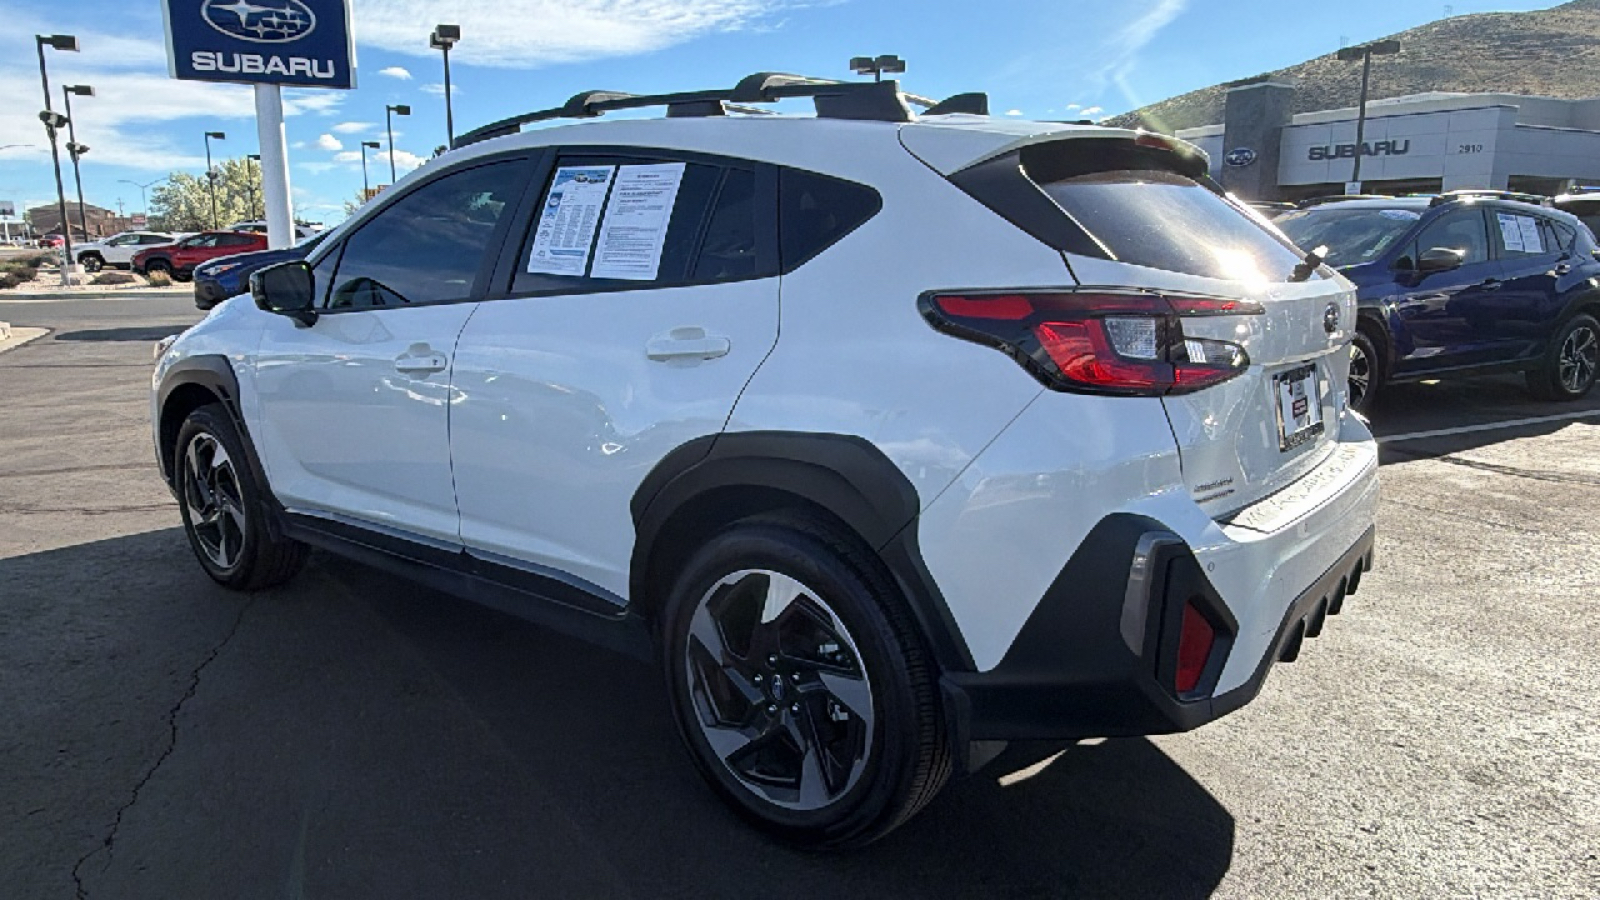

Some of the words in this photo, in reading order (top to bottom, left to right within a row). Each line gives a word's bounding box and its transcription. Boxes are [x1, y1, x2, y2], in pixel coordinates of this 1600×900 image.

[191, 51, 335, 79] SUBARU
[1308, 139, 1410, 161] SUBARU
[1458, 144, 1484, 155] 2910
